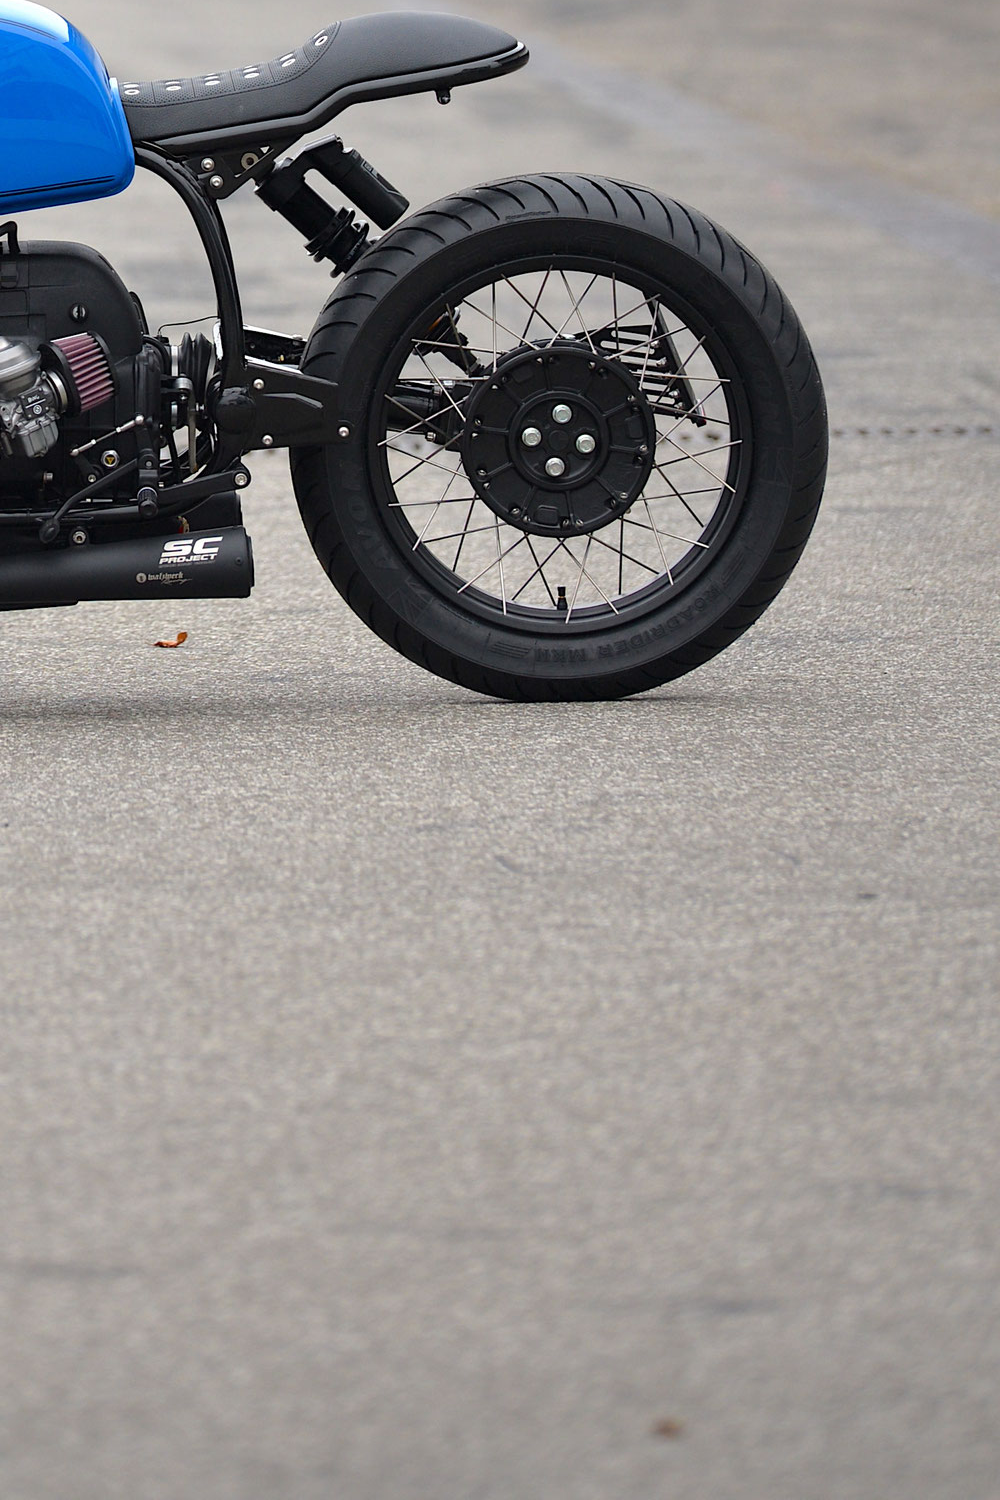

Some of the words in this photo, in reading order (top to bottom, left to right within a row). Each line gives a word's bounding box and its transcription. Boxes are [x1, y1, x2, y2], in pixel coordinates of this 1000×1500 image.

[160, 536, 224, 558] SC
[159, 553, 218, 565] PROJECT
[598, 579, 722, 659] ROADRIDER
